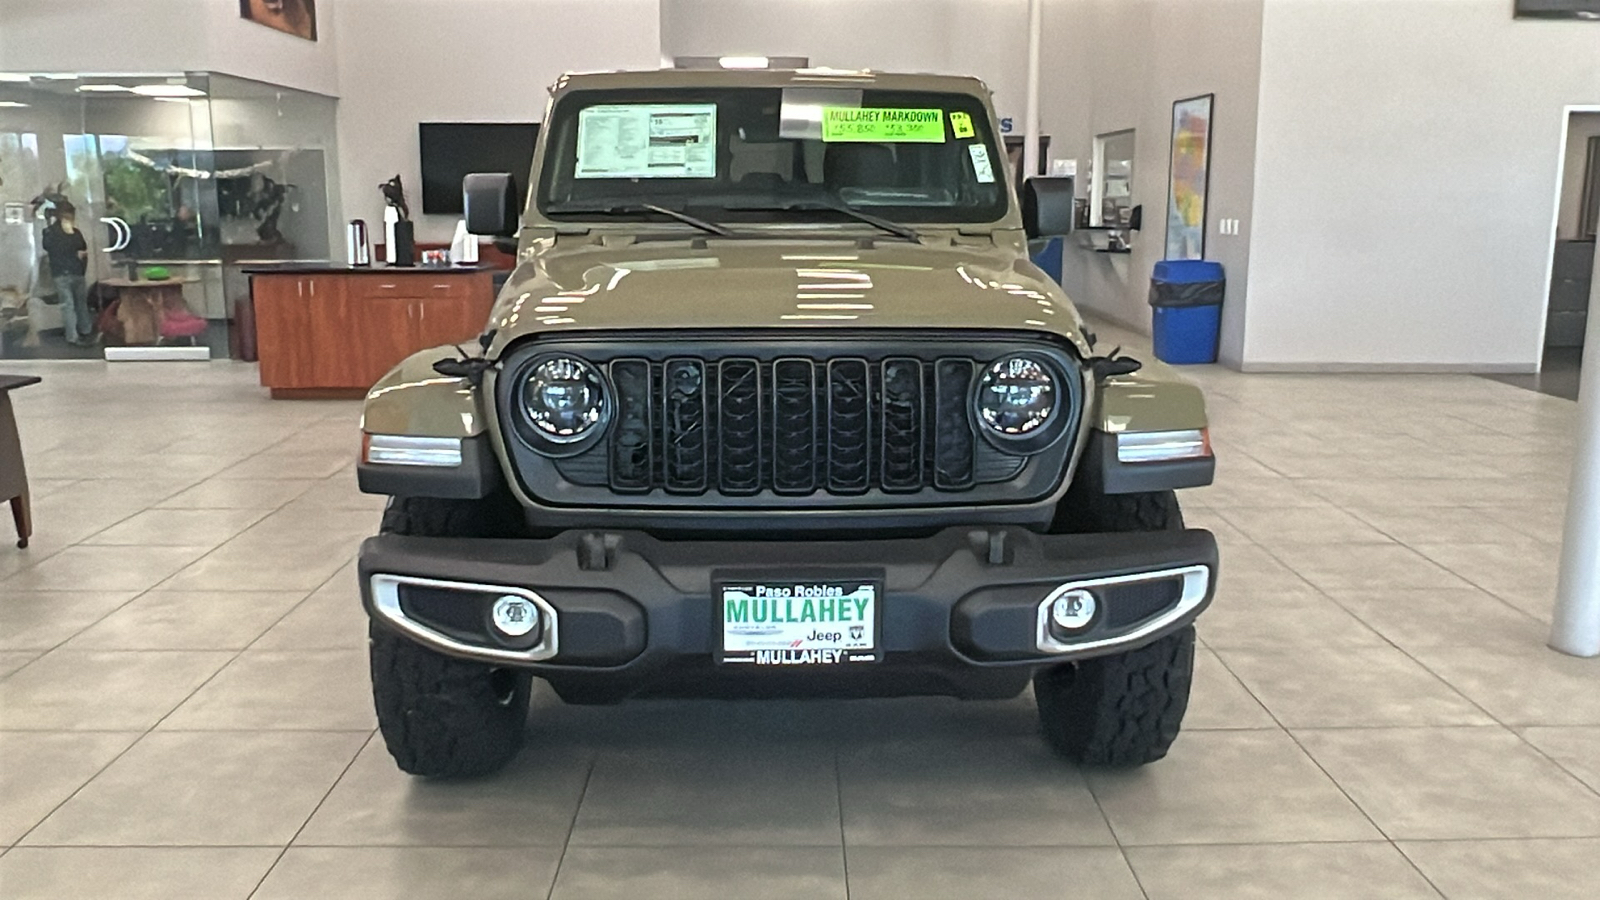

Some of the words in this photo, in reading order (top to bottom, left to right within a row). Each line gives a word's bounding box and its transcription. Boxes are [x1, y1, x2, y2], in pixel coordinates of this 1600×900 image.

[830, 110, 880, 122] MULLAHEY
[882, 111, 939, 122] MARKDOWN
[756, 585, 791, 597] Paso
[794, 585, 843, 598] Robles
[726, 598, 869, 622] MULLAHEY
[807, 629, 843, 643] Jeep
[756, 650, 844, 664] MULLAHEY
